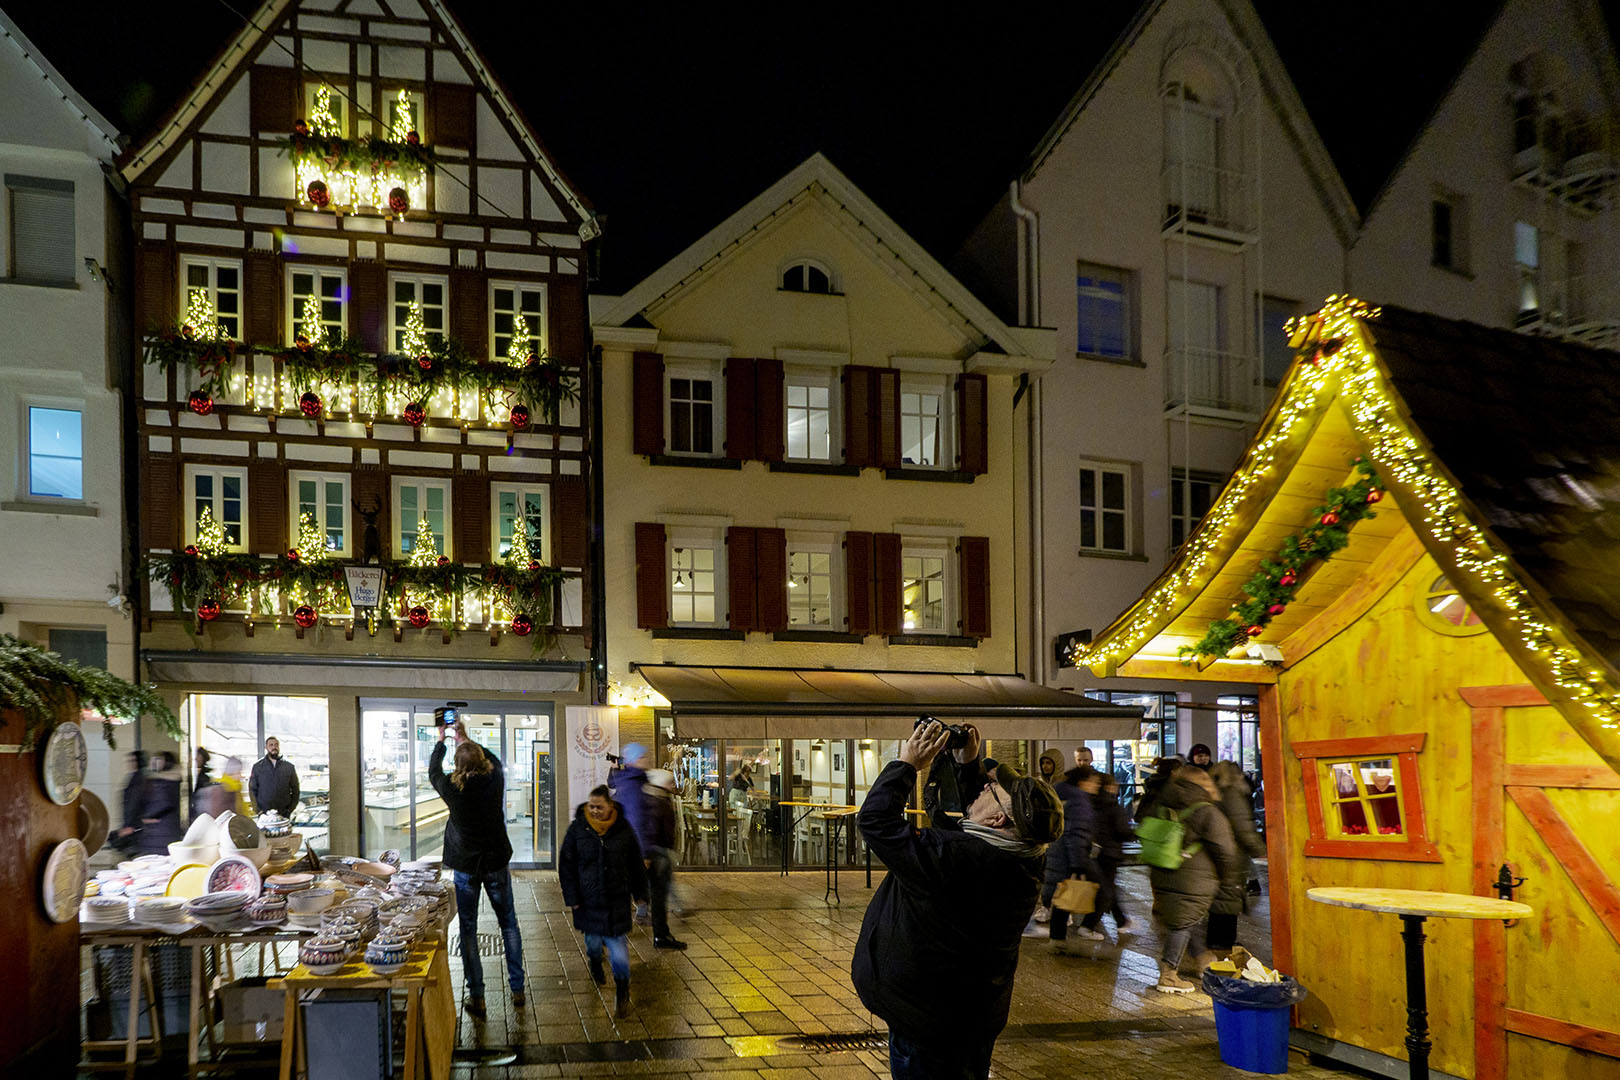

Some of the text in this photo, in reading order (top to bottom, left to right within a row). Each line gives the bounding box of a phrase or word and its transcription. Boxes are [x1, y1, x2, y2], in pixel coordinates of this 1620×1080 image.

[348, 568, 379, 579] Bäckerei
[355, 586, 374, 596] Hugo
[354, 593, 376, 602] Berger
